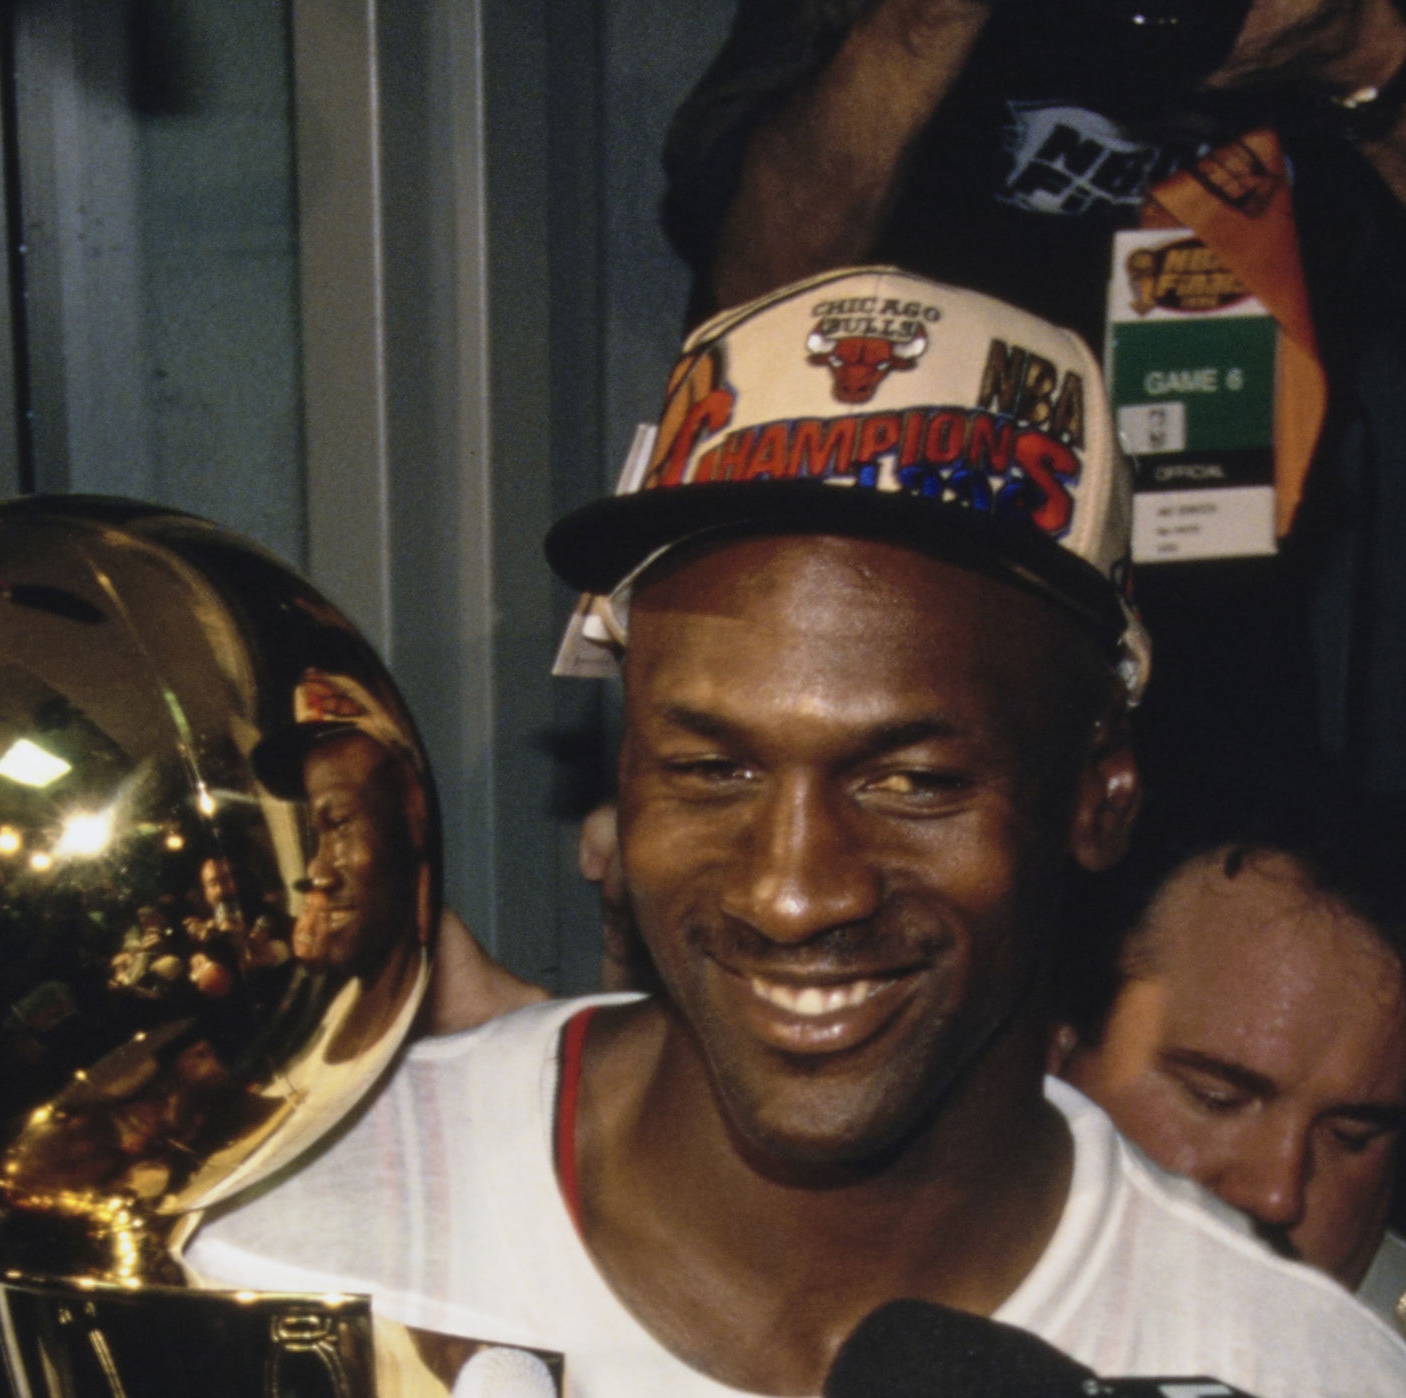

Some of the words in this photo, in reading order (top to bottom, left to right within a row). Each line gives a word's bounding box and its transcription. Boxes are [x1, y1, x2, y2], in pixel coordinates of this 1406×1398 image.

[811, 297, 941, 323] CHICAGO
[820, 317, 922, 341] BULLS
[978, 335, 1086, 450] NBA
[1145, 368, 1219, 395] GAME
[1225, 367, 1244, 392] 6
[658, 386, 1082, 534] CHAMPIONS
